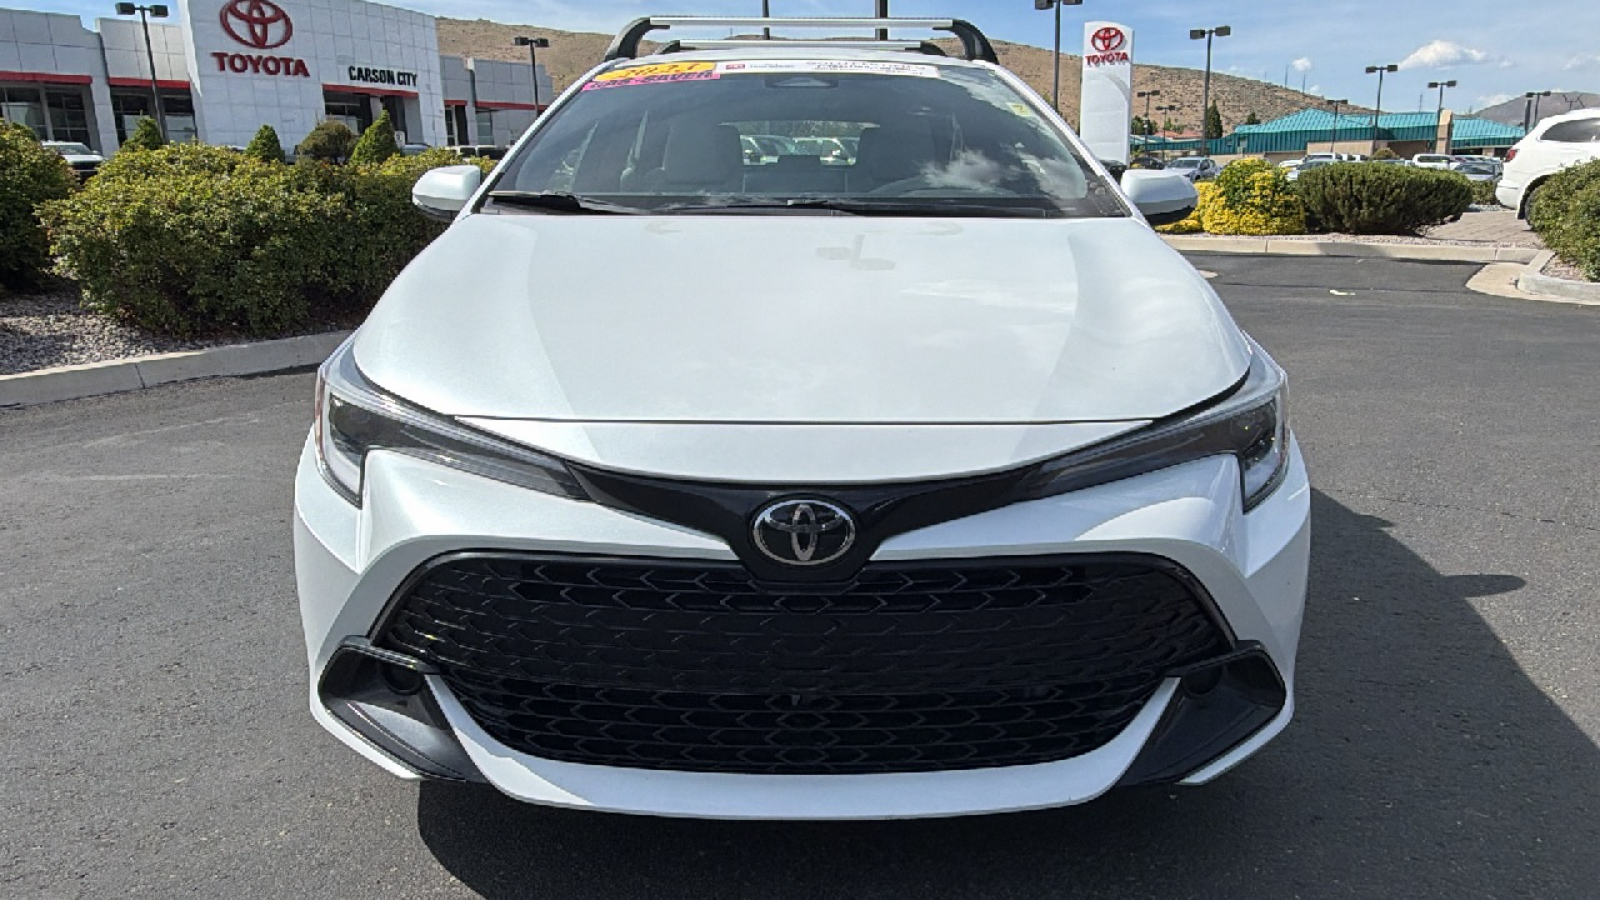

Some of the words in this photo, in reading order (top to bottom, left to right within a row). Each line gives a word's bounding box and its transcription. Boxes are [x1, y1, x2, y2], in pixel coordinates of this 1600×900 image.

[210, 51, 310, 77] TOYOTA
[1085, 52, 1129, 65] TOYOTA
[348, 65, 395, 85] CARSON
[397, 70, 417, 87] CITY
